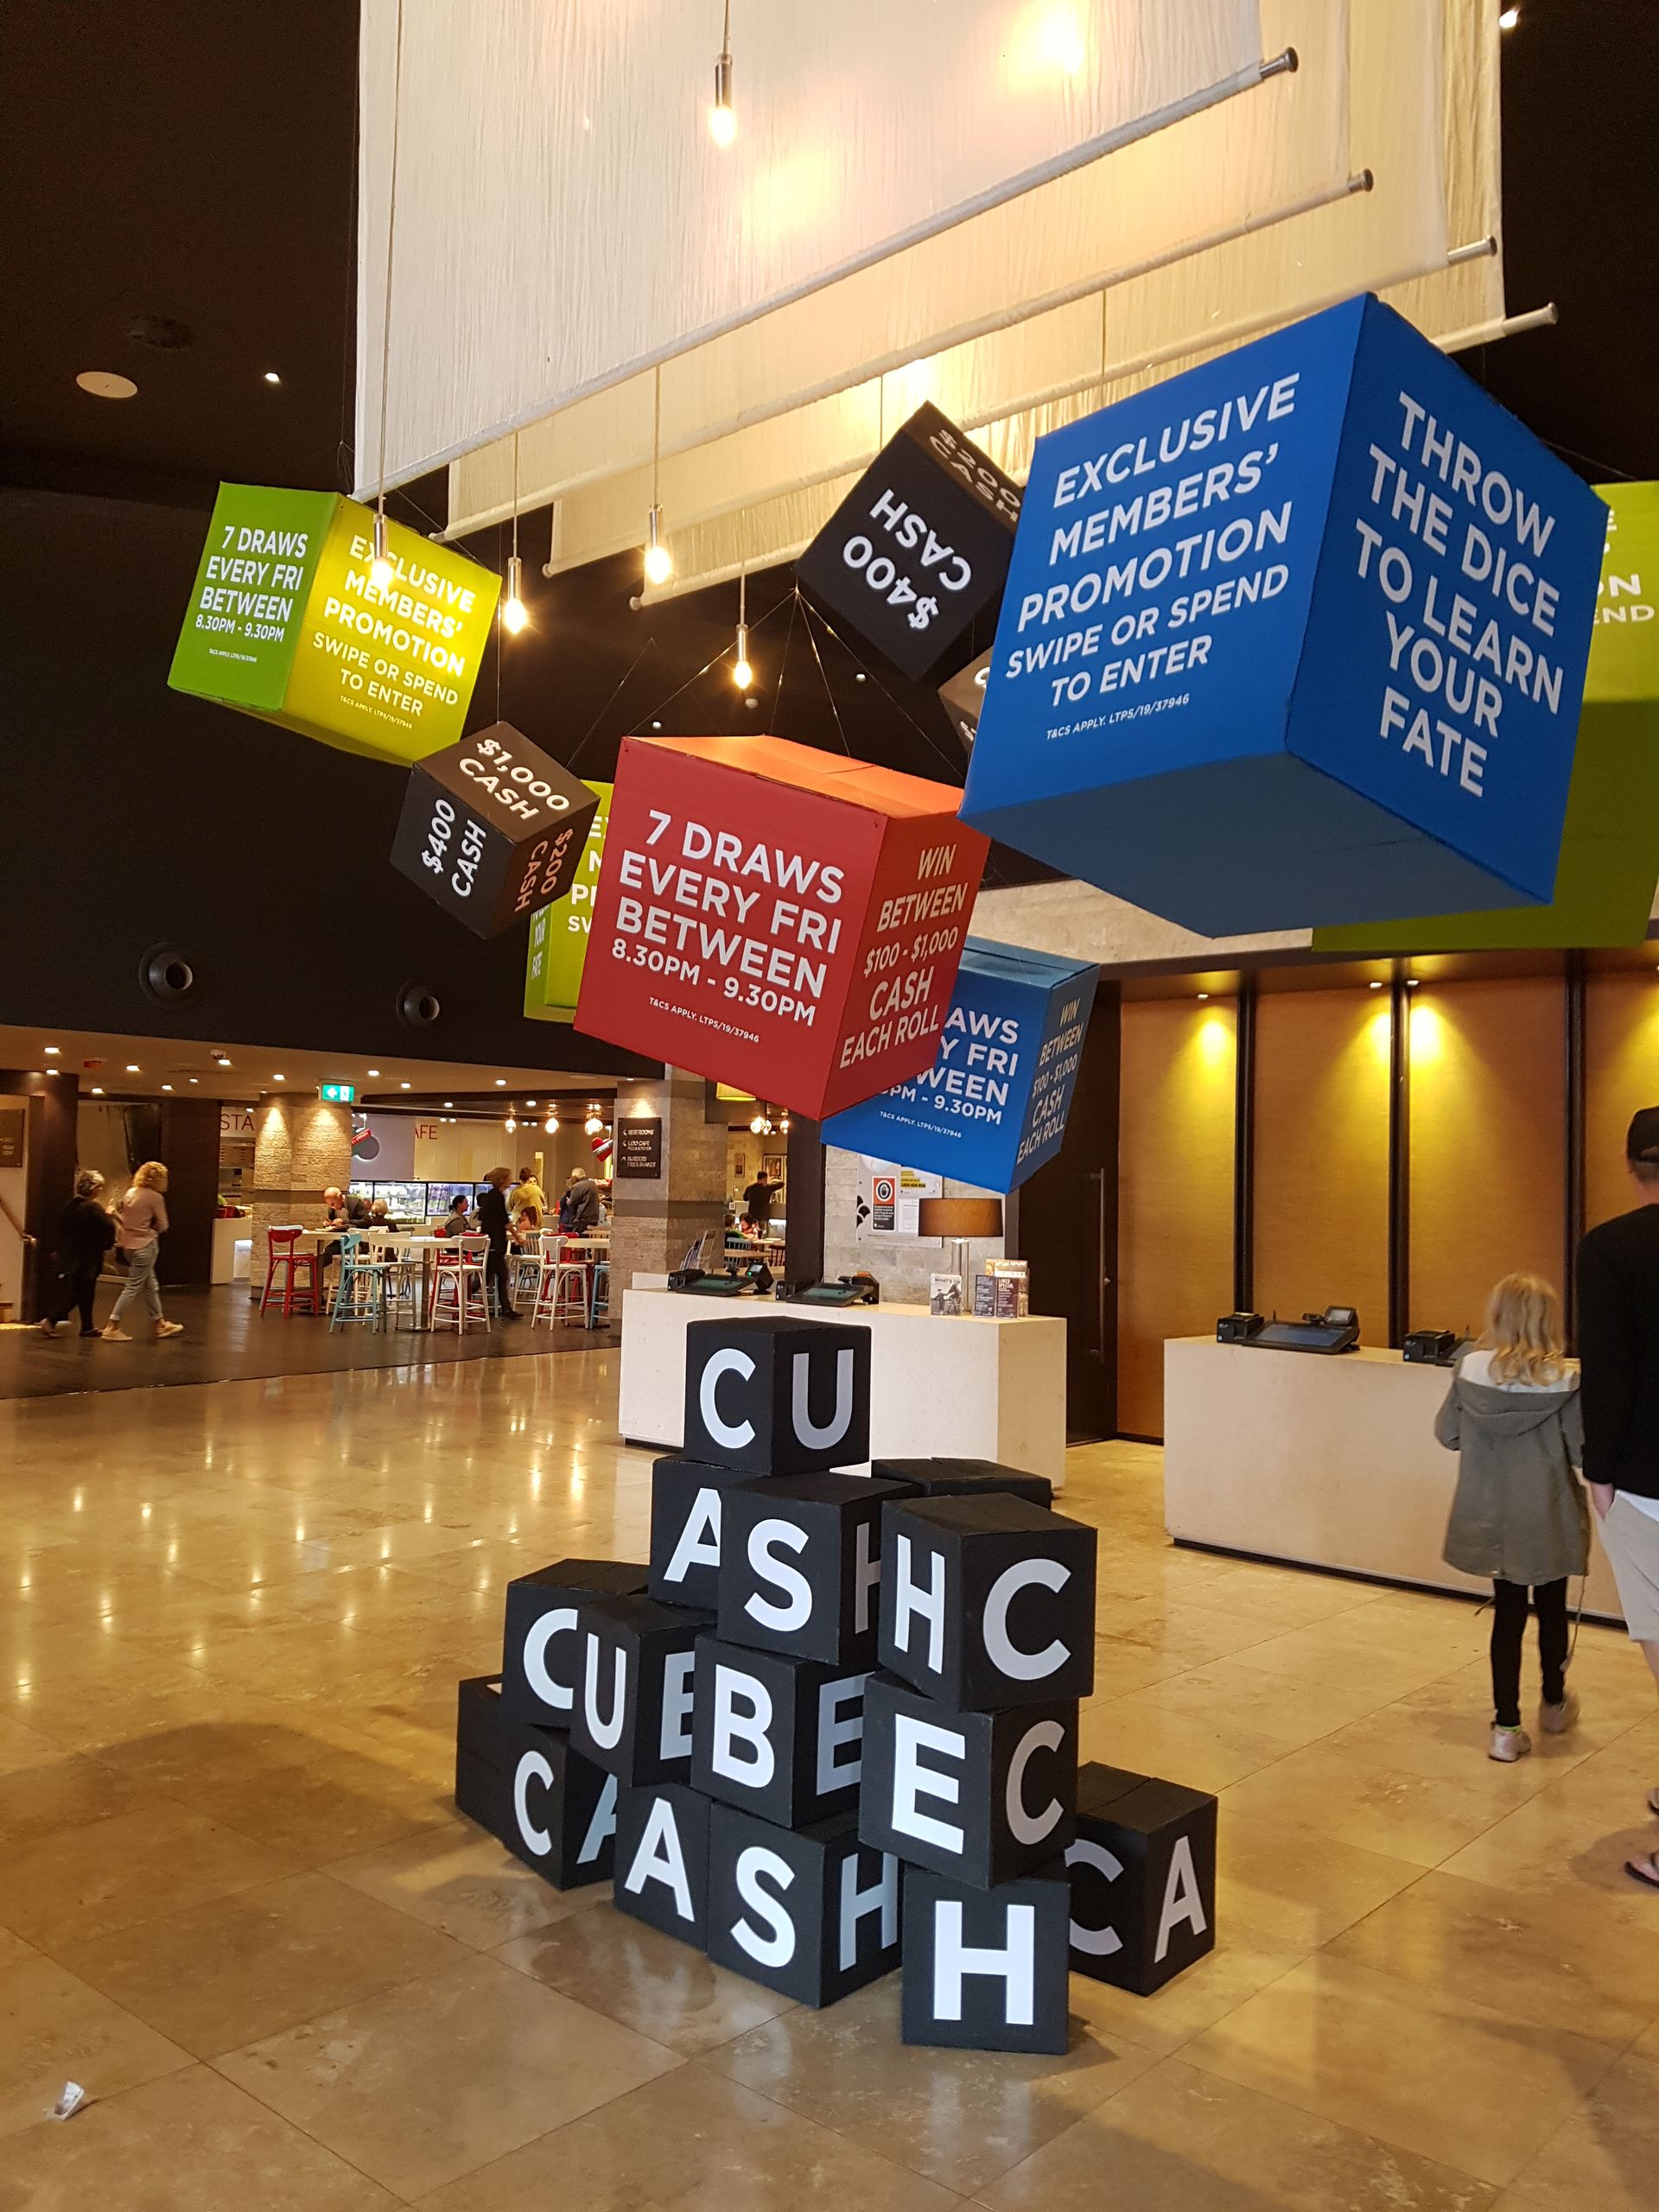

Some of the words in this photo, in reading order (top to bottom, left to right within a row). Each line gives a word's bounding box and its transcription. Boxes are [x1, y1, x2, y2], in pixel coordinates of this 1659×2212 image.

[929, 435, 1019, 522] CASH
[1052, 372, 1300, 508] EXCLUSIVE
[1398, 391, 1555, 557] THROW
[206, 556, 265, 587] EVERY
[271, 563, 304, 590] FRI
[220, 526, 235, 549] 7
[238, 528, 308, 558] DRAWS
[842, 536, 939, 630] $400
[869, 488, 971, 591] CASH
[1017, 501, 1293, 633] PROMOTION
[1369, 443, 1453, 556] THE
[1461, 524, 1560, 637] DICE
[195, 614, 235, 634] 8.30PM
[245, 622, 284, 642] 9.30PM
[200, 587, 293, 621] BETWEEN
[323, 597, 465, 677] PROMOTION
[1006, 624, 1103, 679] SWIPE
[1111, 607, 1160, 646] OR
[1167, 564, 1290, 629] SPEND
[1356, 518, 1413, 604] TO
[1423, 575, 1564, 715] LEARN
[313, 632, 370, 669] SWIPE
[374, 654, 398, 681] OR
[404, 670, 459, 705] SPEND
[340, 668, 363, 690] TO
[367, 681, 423, 716] ENTER
[1051, 671, 1091, 708] TO
[1099, 635, 1212, 694] ENTER
[1385, 610, 1503, 738] YOUR
[477, 738, 569, 810] $1,000
[1046, 724, 1071, 741] T&CS
[1380, 685, 1488, 798] FATE
[459, 758, 539, 820] CASH
[422, 799, 455, 874] $400
[451, 819, 486, 897] CASH
[514, 840, 549, 912] CASH
[541, 828, 573, 894] $200
[645, 809, 672, 846] 7
[682, 821, 844, 905] DRAWS
[918, 844, 957, 880] WIN
[620, 849, 761, 924] EVERY
[771, 899, 842, 954] FRI
[877, 881, 969, 933] BETWEEN
[612, 938, 700, 987] 8.30PM
[723, 976, 817, 1027] 9.30PM
[615, 896, 828, 999] BETWEEN
[864, 942, 899, 978] $100
[911, 926, 959, 963] $1,000
[649, 996, 670, 1011] T&CS
[699, 1014, 760, 1043] LTPS/19/37946
[840, 1020, 893, 1069] EACH
[894, 1005, 939, 1046] ROLL
[869, 966, 935, 1021] CASH
[1059, 997, 1080, 1027] WIN
[914, 1066, 1009, 1107] WEEN
[966, 1042, 1019, 1077] FRI
[1033, 1074, 1049, 1099] $100
[1054, 1053, 1078, 1082] $1,000
[1039, 1023, 1084, 1067] BETWEEN
[220, 1113, 254, 1131] STA
[934, 1095, 1001, 1125] 9.30PM
[1017, 1126, 1043, 1165] EACH
[1043, 1110, 1065, 1141] ROLL
[1033, 1084, 1065, 1128] CASH
[700, 1348, 756, 1449] C
[791, 1349, 855, 1450] U
[663, 1487, 722, 1582] A
[744, 1519, 813, 1632] S
[894, 1534, 945, 1675] H
[982, 1558, 1072, 1681] C
[523, 1608, 578, 1710] C
[585, 1632, 626, 1749] U
[712, 1663, 775, 1789] B
[817, 1671, 874, 1796] E
[513, 1750, 554, 1856] C
[892, 1713, 966, 1855] E
[1006, 1720, 1065, 1846] C
[624, 1796, 695, 1923] A
[1154, 1835, 1207, 1964] A
[729, 1846, 796, 1968] S
[840, 1850, 898, 1972] H
[932, 1900, 1035, 2026] H
